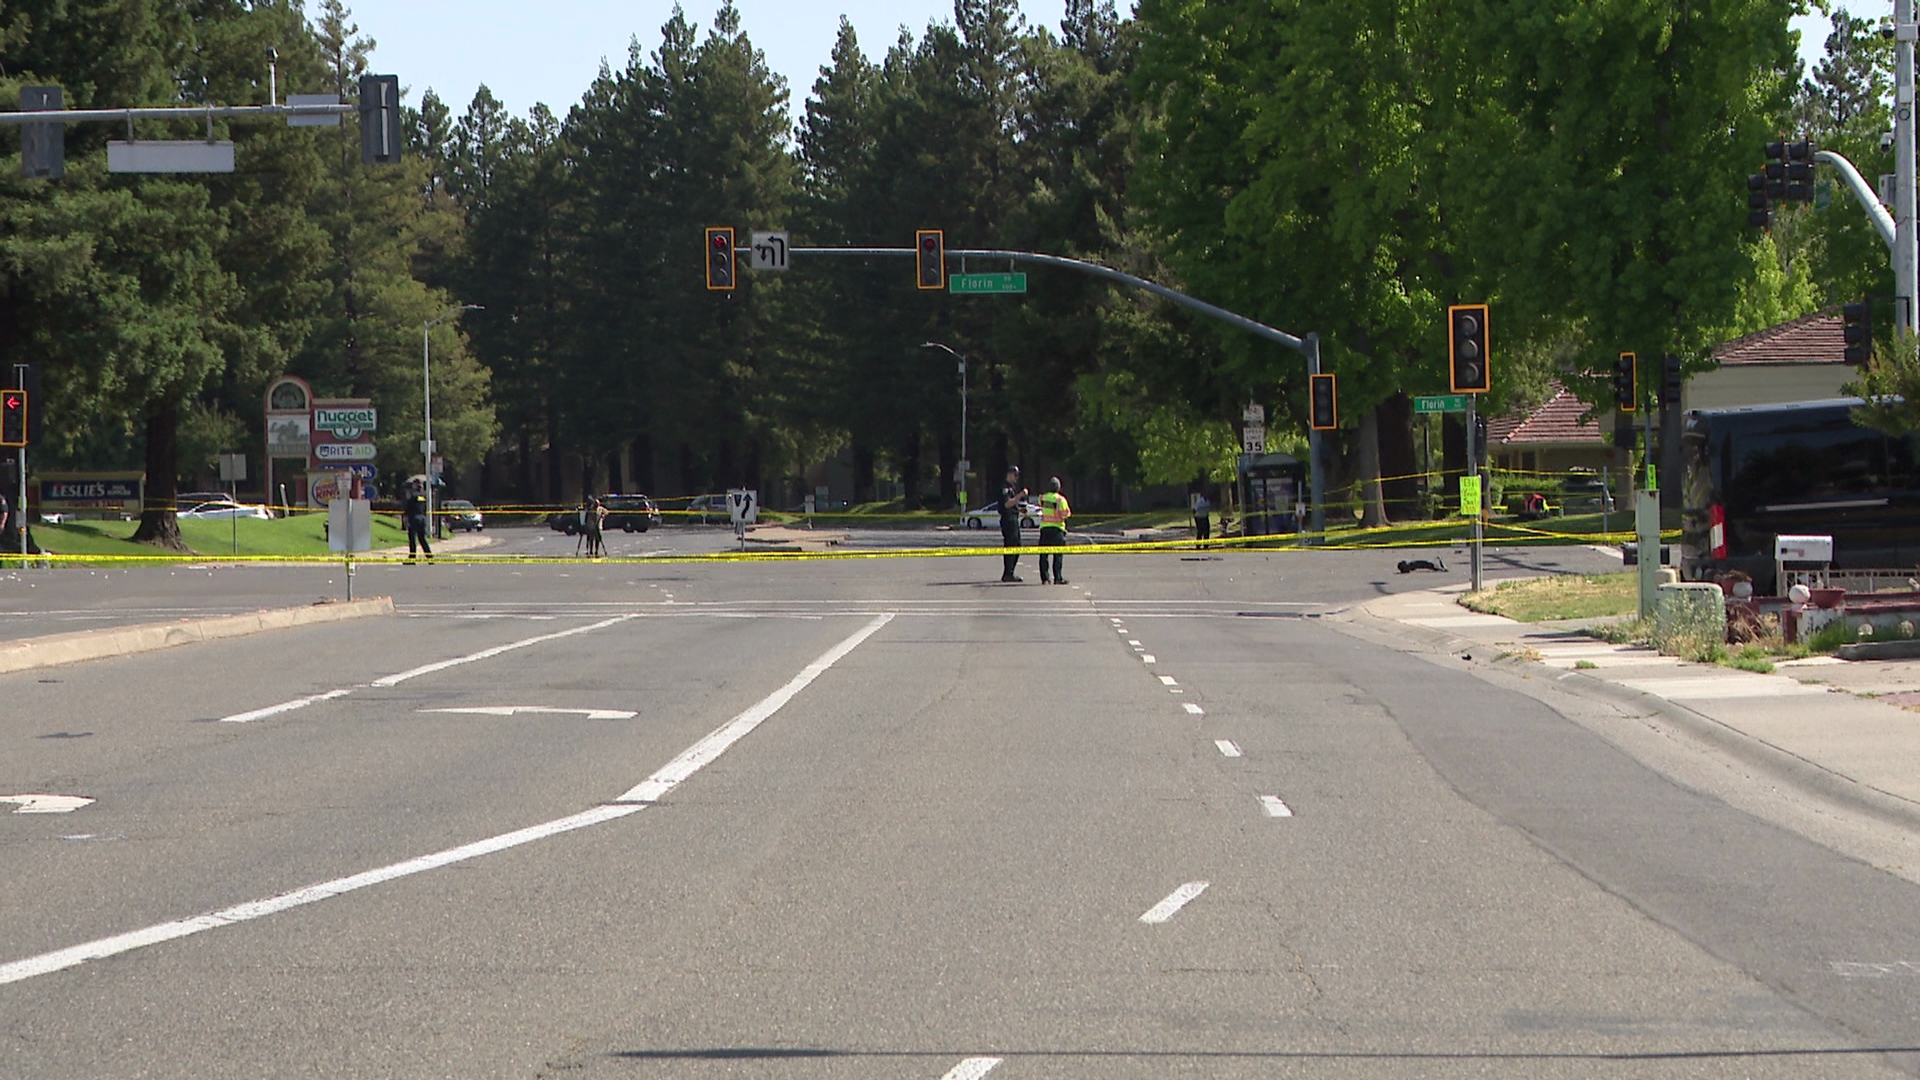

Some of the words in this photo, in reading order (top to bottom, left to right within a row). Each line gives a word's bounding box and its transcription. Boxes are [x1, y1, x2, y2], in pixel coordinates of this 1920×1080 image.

[961, 277, 994, 289] Florin
[1421, 399, 1446, 410] Florin
[330, 446, 353, 455] RITE
[354, 446, 372, 455] AID
[1246, 441, 1262, 451] 35
[52, 482, 106, 498] LESLIE'S
